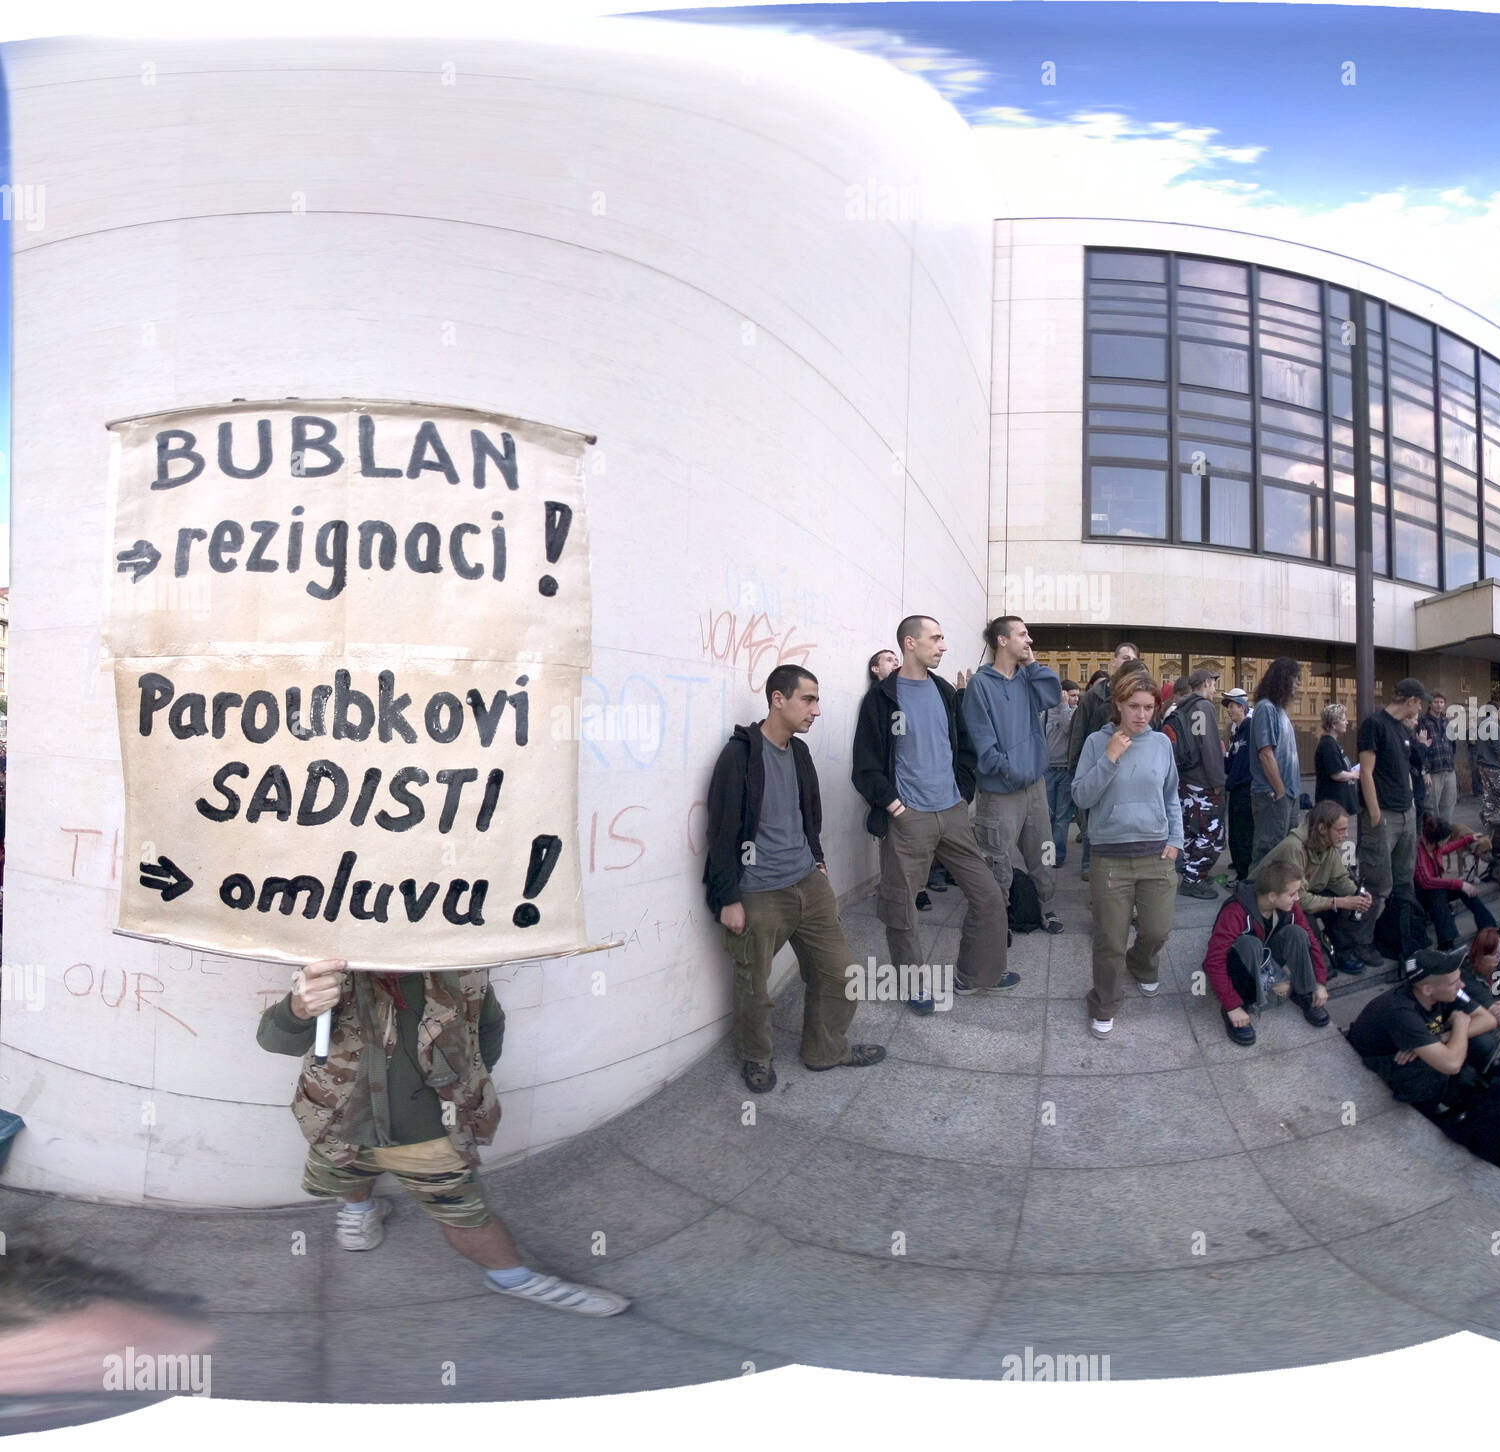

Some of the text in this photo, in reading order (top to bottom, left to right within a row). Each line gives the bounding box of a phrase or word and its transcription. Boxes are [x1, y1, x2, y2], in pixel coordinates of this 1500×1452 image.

[150, 414, 518, 491] BUBLAN
[174, 505, 507, 600] rezignaci
[196, 759, 503, 834] SADISTI
[512, 834, 562, 928] !
[63, 962, 198, 1037] OUR
